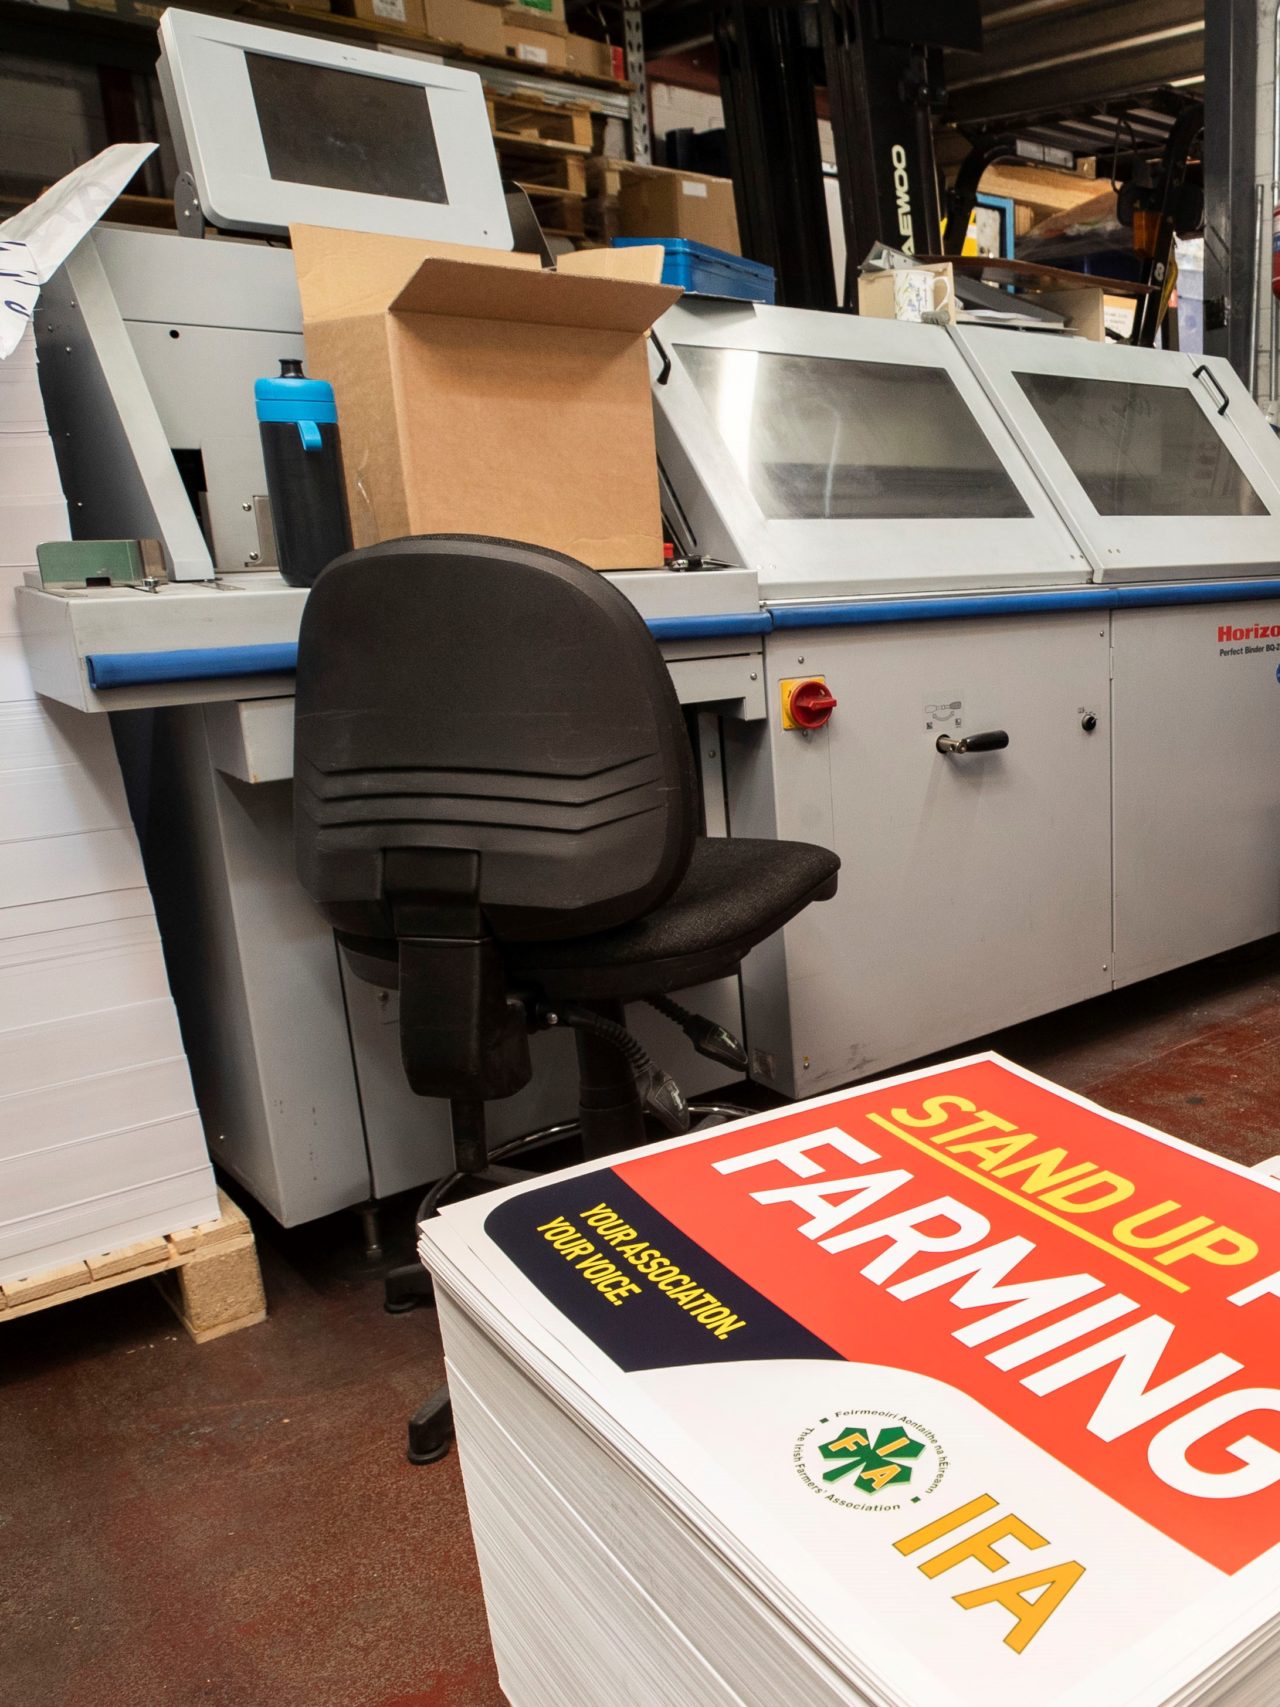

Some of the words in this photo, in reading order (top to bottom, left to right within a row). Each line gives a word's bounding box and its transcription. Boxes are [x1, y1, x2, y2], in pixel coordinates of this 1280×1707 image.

[891, 144, 915, 256] AEWOO
[1220, 647, 1243, 657] Perfect
[1245, 645, 1265, 654] Binder
[891, 1095, 1135, 1214] STAND
[1112, 1200, 1259, 1266] UP
[537, 1216, 595, 1261] YOUR
[575, 1253, 642, 1306] VOICE.
[580, 1202, 638, 1246] YOUR
[616, 1242, 746, 1340] ASSOCIATION.
[793, 1443, 804, 1461] Irish
[797, 1427, 815, 1441] The
[899, 1416, 938, 1444] Aontaithe
[934, 1445, 945, 1454] na
[826, 1493, 900, 1512] Association
[892, 1493, 1086, 1654] IFA
